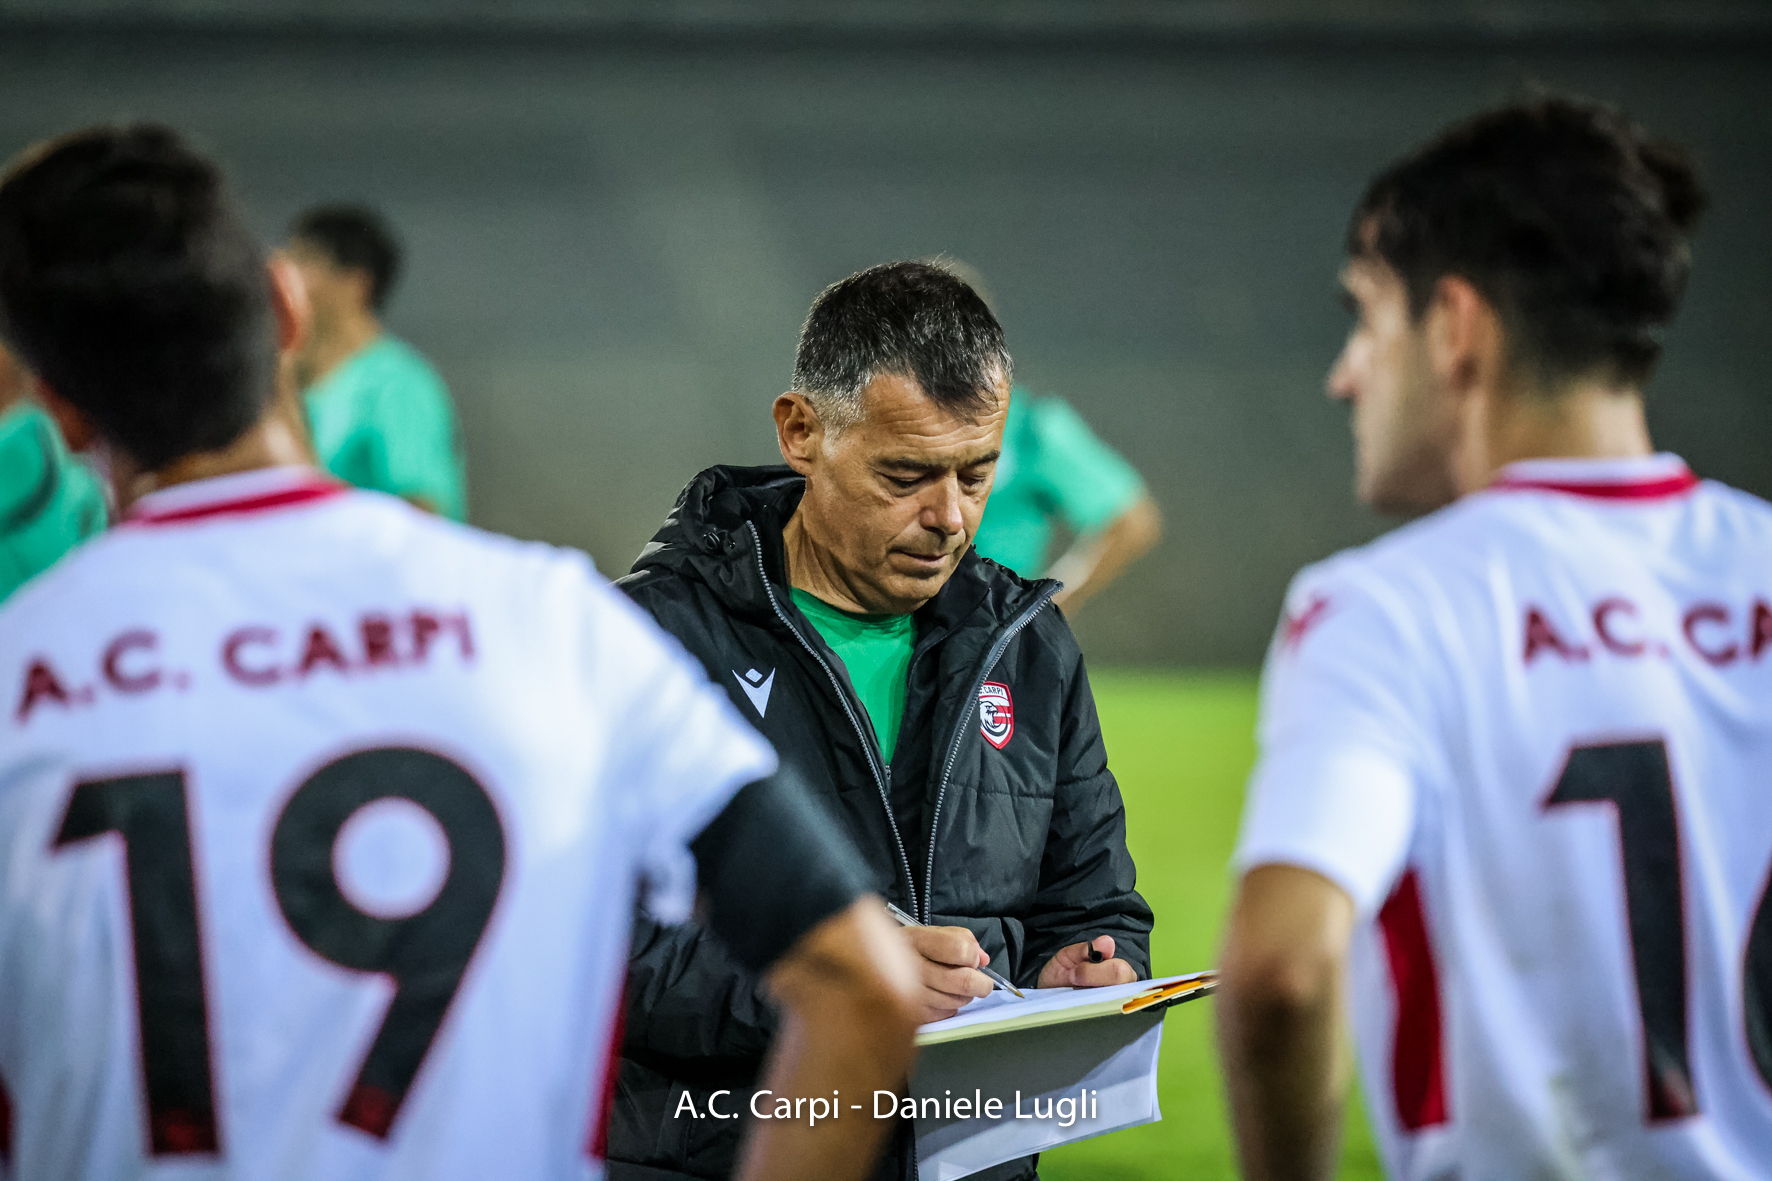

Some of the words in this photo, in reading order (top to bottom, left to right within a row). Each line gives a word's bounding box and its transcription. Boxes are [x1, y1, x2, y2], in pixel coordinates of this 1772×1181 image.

[220, 611, 476, 688] CARPI
[49, 745, 508, 1159] 19
[1540, 735, 1772, 1127] 1
